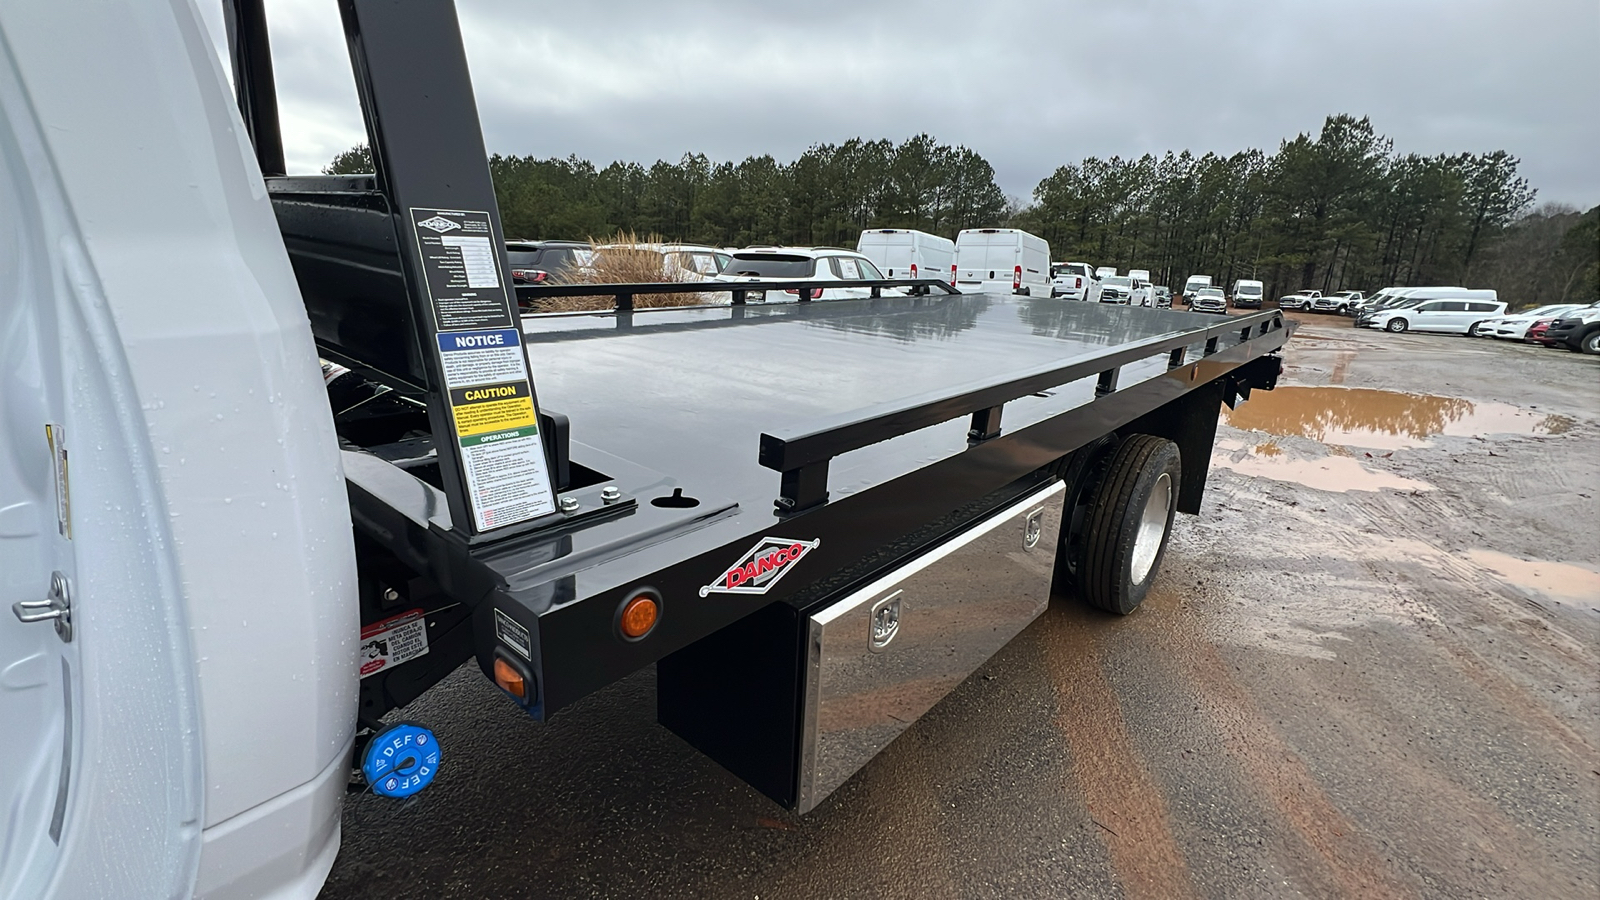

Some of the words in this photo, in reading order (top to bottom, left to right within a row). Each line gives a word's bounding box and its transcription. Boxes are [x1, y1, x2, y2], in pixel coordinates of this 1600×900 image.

[456, 334, 504, 347] NOTICE
[465, 386, 516, 400] CAUTION
[481, 431, 519, 442] OPERATIONS
[727, 543, 803, 589] DANCO
[389, 634, 402, 642] META
[403, 626, 422, 636] DEBAJO
[393, 640, 413, 651] CUANDO
[393, 647, 410, 656] MOTOR
[383, 735, 412, 757] DEF
[402, 766, 430, 788] DEF
